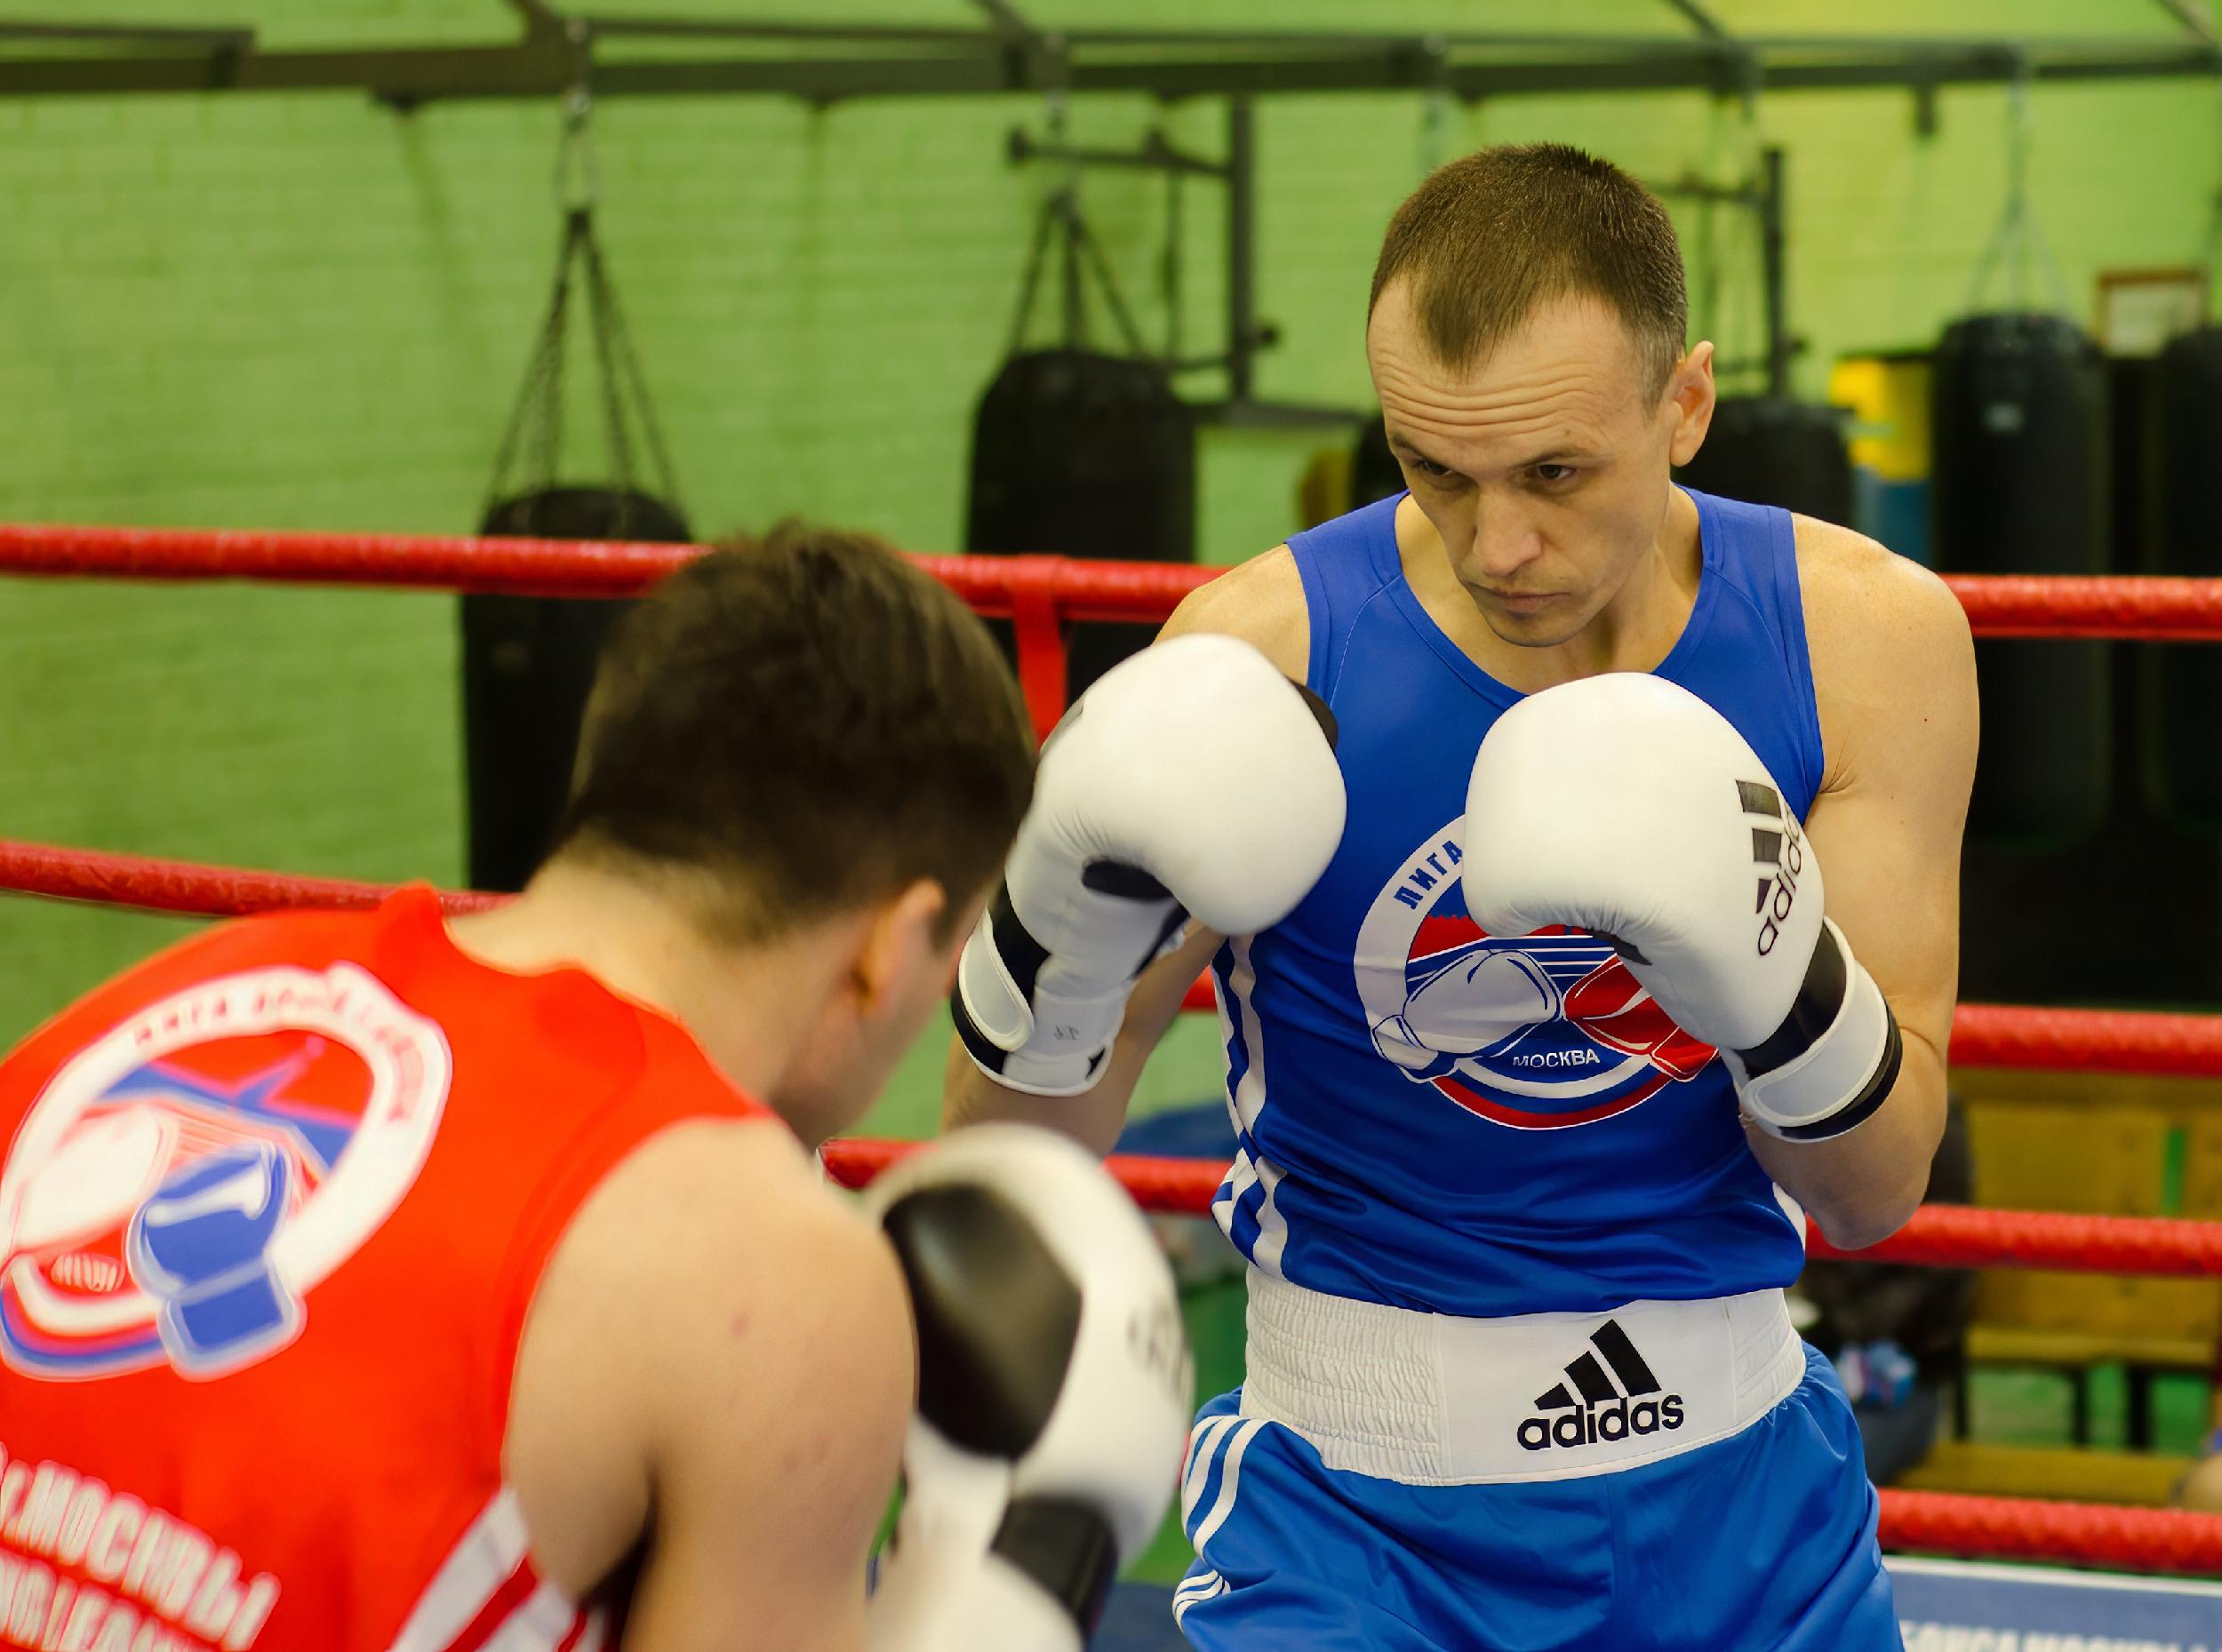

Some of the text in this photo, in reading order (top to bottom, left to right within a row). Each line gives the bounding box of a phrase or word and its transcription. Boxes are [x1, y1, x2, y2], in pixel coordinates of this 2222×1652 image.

[1394, 840, 1462, 910] ЛИГА
[1513, 1048, 1600, 1067] МОСКВА
[1516, 1394, 1684, 1451] adidas
